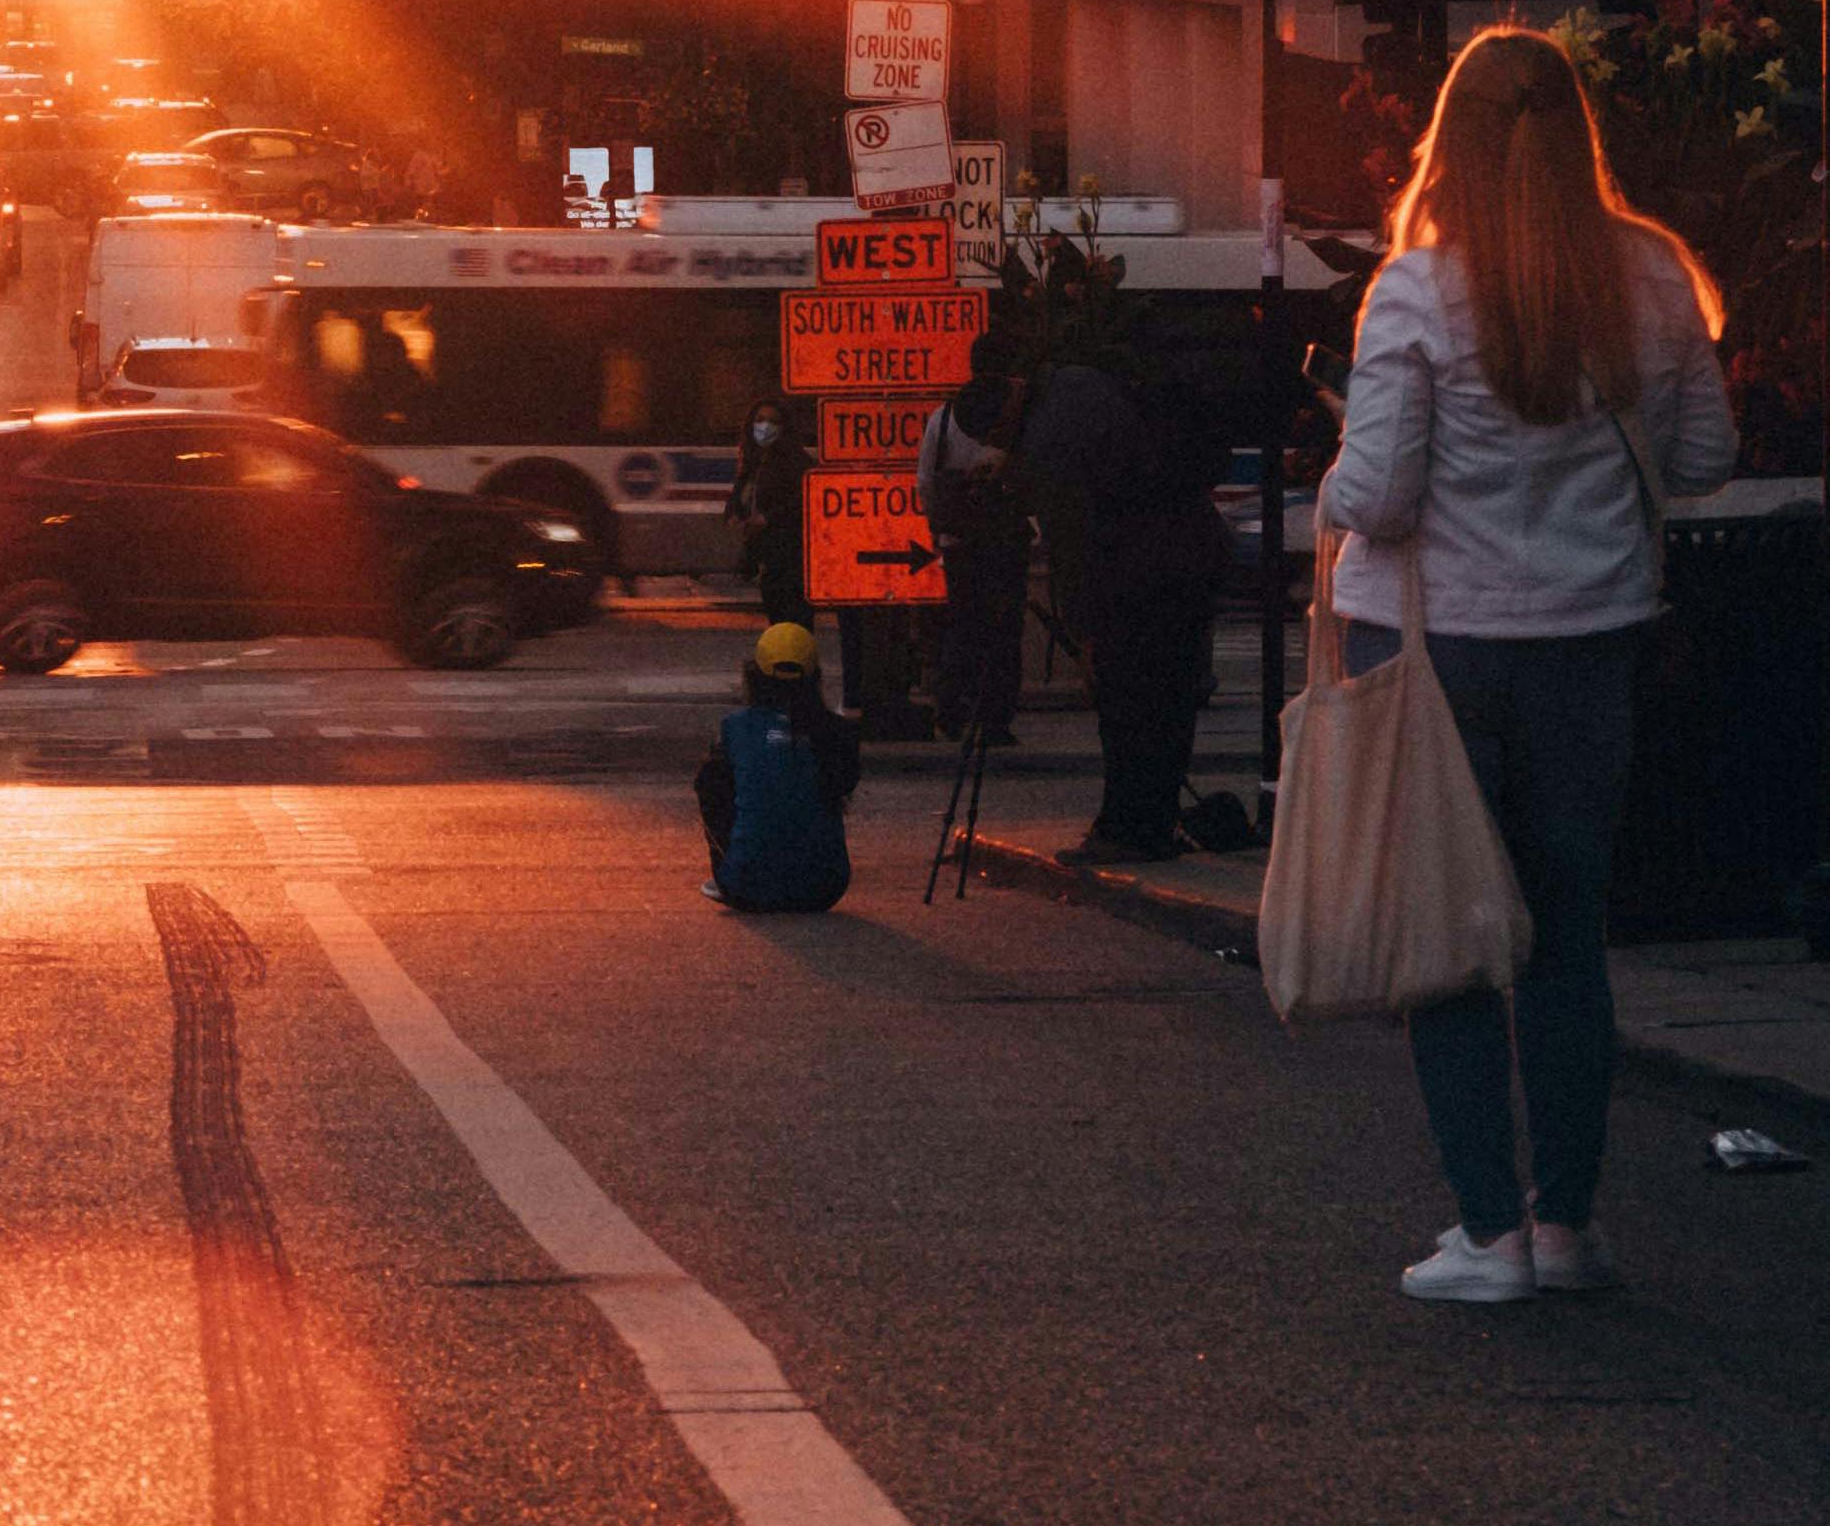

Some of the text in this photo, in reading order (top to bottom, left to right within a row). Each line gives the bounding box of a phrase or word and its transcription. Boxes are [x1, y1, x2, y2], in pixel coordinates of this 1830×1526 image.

[887, 7, 913, 32] NO
[854, 34, 943, 62] CRUISING
[872, 63, 922, 89] ZONE
[864, 185, 949, 209] TOW ZONE
[827, 233, 943, 269] WEST
[793, 300, 975, 335] SOUTH WATER
[834, 348, 934, 381] STREET
[833, 412, 928, 449] TRUC
[823, 487, 927, 518] DETOU
